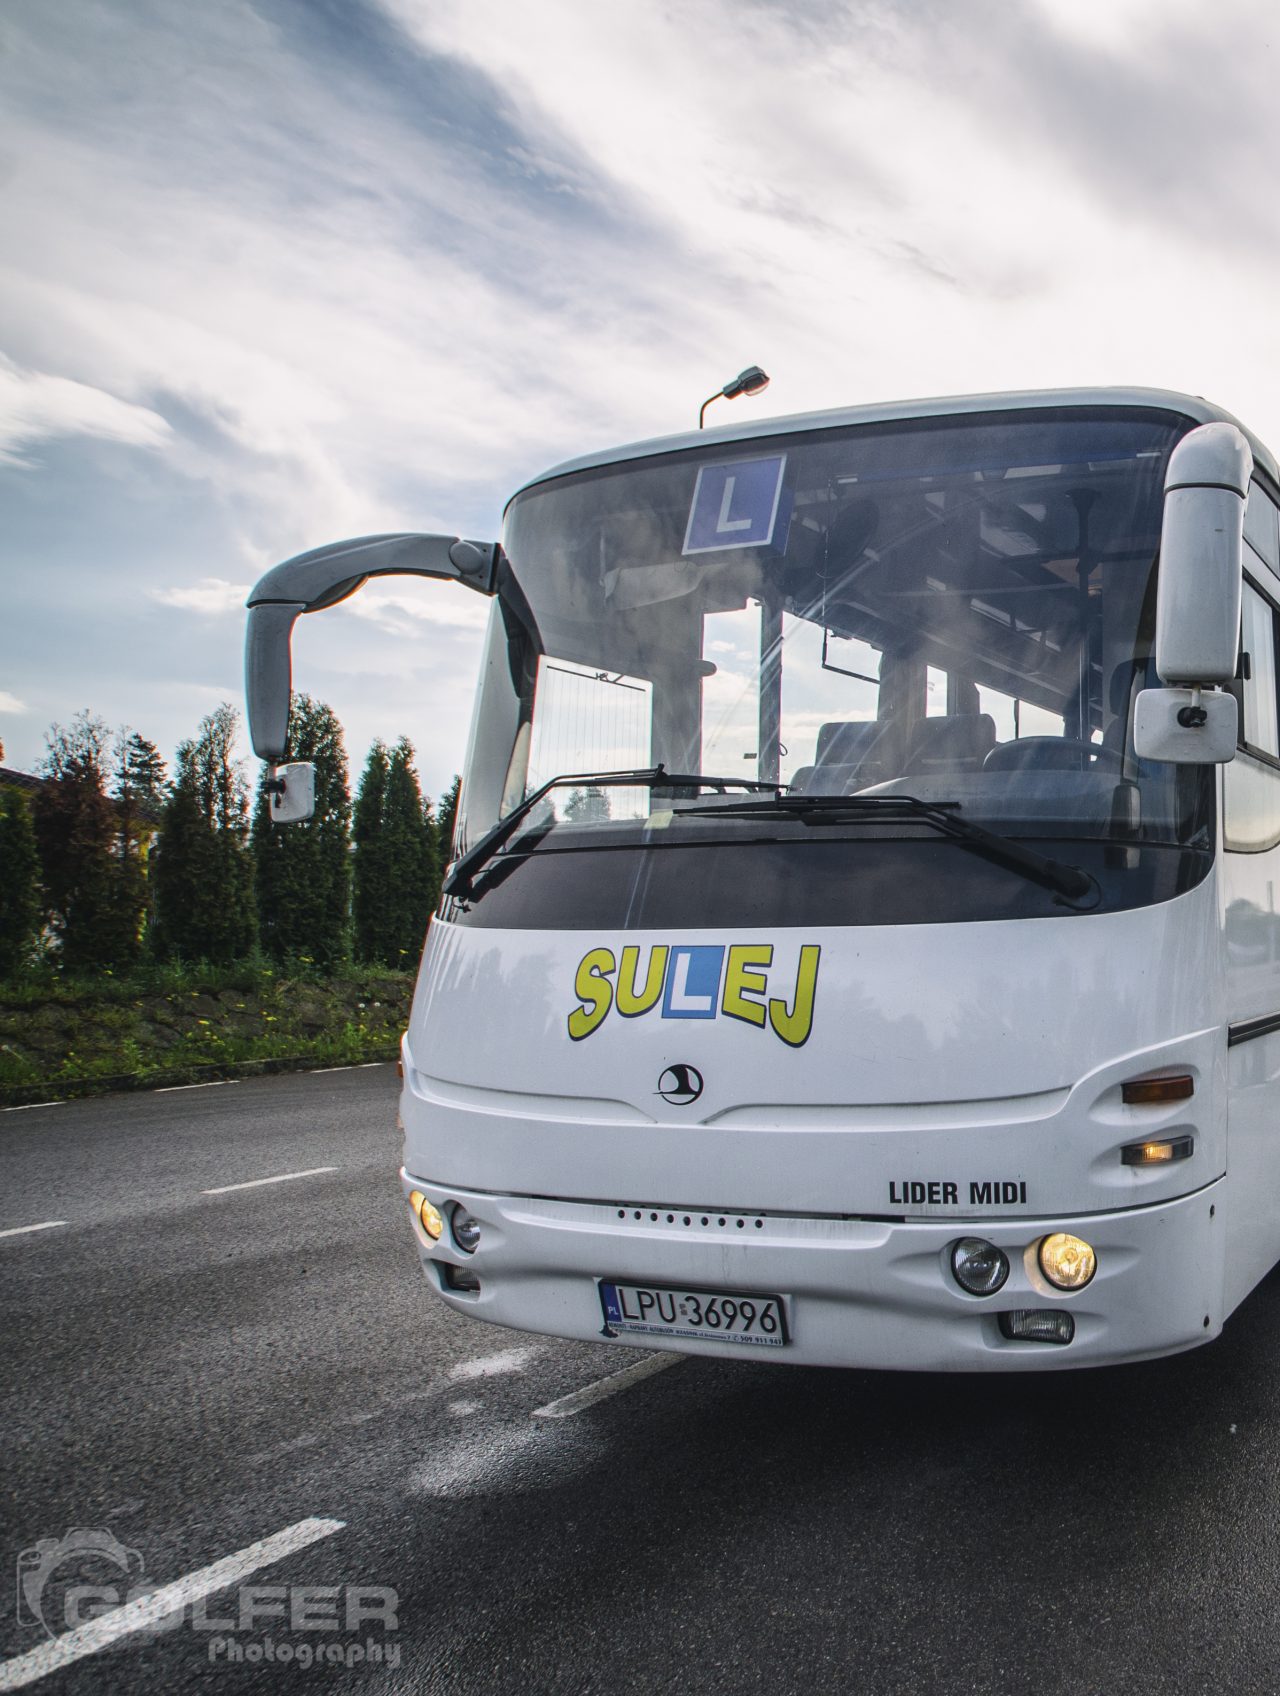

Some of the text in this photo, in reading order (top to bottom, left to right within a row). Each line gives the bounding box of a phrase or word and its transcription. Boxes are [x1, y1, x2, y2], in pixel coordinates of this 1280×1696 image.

[716, 476, 753, 533] L
[568, 944, 821, 1048] SULEJ
[889, 1181, 1027, 1205] LIDER MIDI
[607, 1306, 619, 1316] PL
[618, 1288, 777, 1334] LPU 36996
